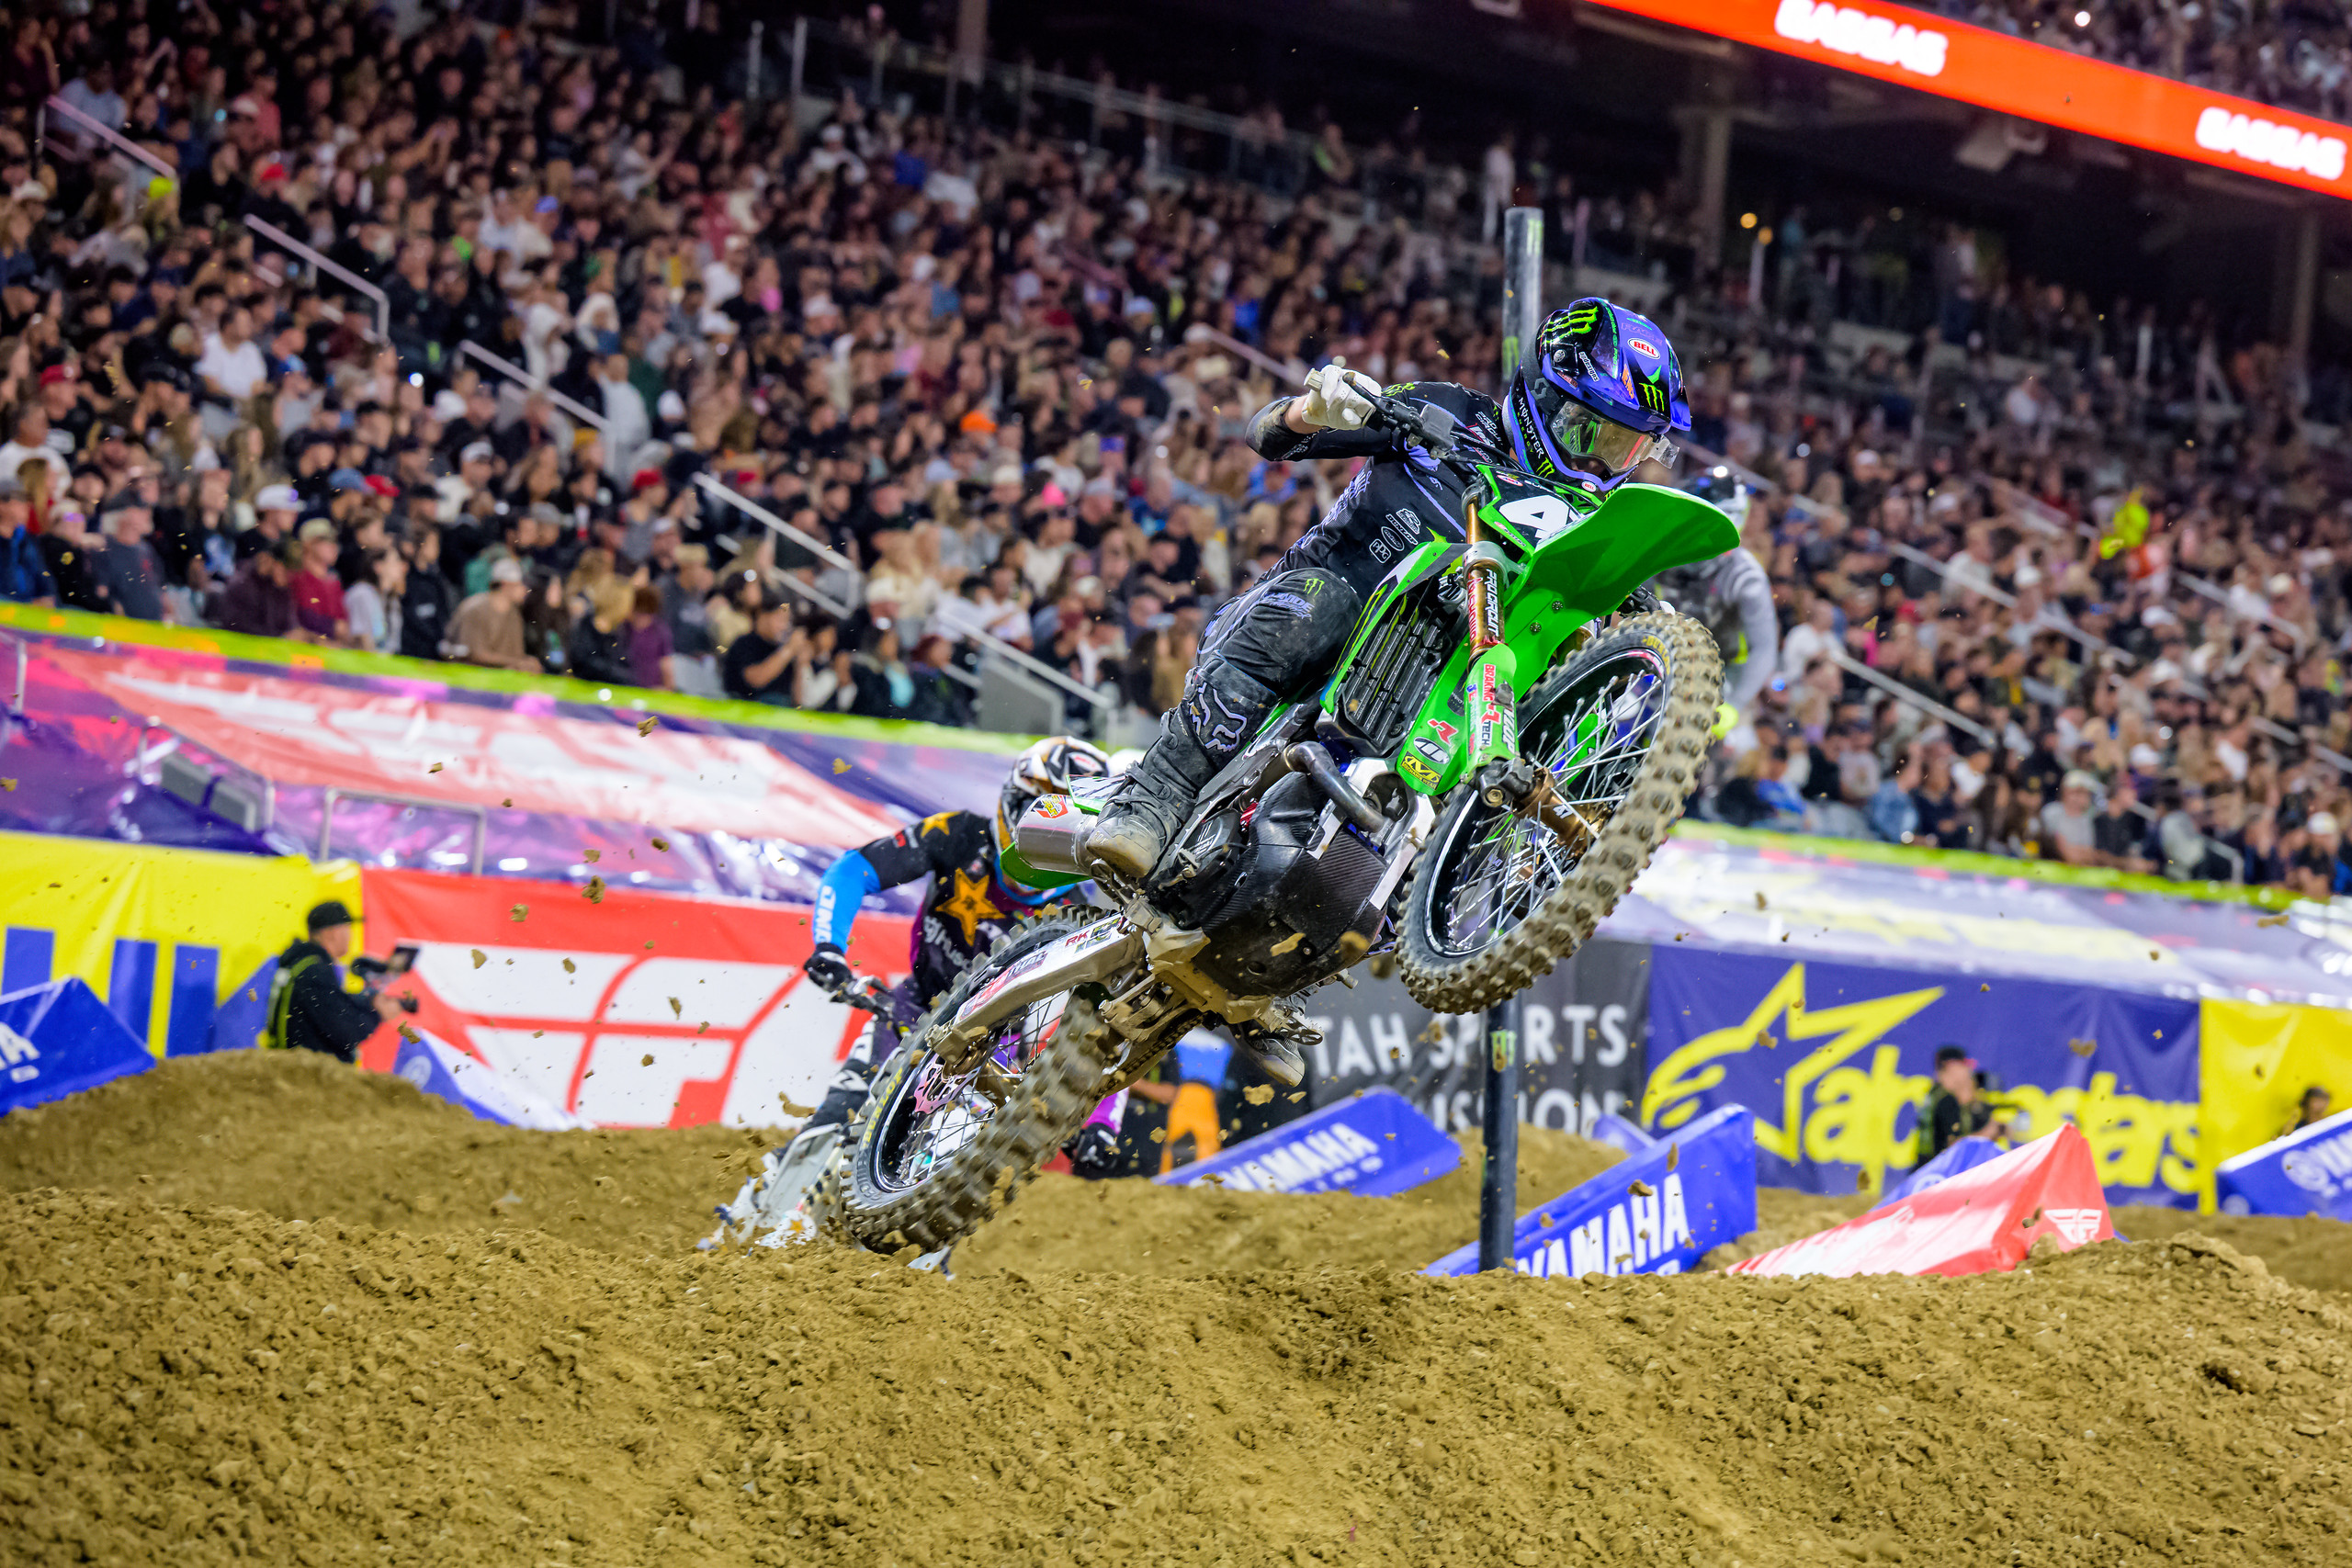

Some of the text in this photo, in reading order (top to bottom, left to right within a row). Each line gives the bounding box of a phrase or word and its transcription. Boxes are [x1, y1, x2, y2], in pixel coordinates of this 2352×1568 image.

[1634, 341, 1657, 356] BELL
[1385, 514, 1418, 545] DUNLOP
[1499, 494, 1582, 544] 4
[1483, 663, 1496, 702] BRAKING
[1065, 931, 1090, 948] RK
[1309, 1004, 1628, 1077] TAH SPRTS
[864, 1066, 904, 1145] DUNLOP
